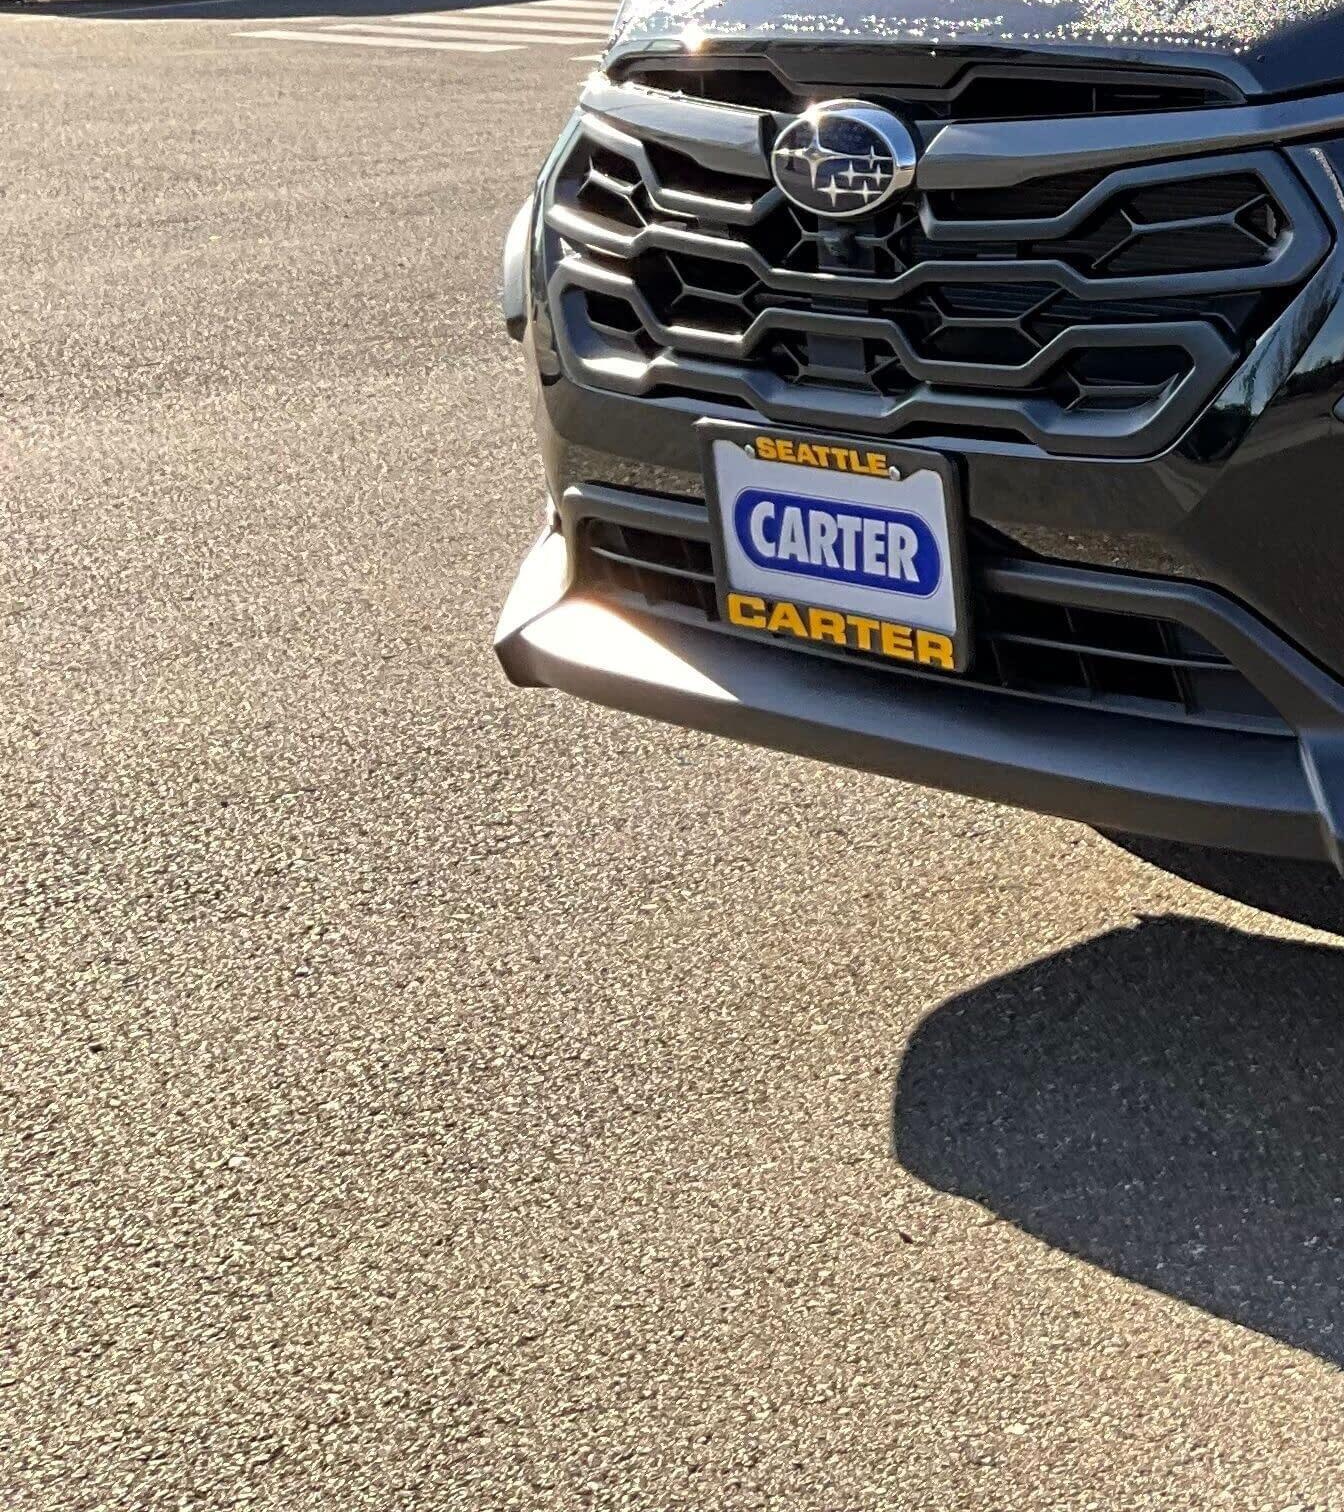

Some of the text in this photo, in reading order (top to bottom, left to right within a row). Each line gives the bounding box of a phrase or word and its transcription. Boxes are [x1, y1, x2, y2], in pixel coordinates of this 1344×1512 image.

[755, 436, 889, 476] SEATTLE
[750, 501, 920, 583] CARTER
[728, 592, 956, 670] CARTER
